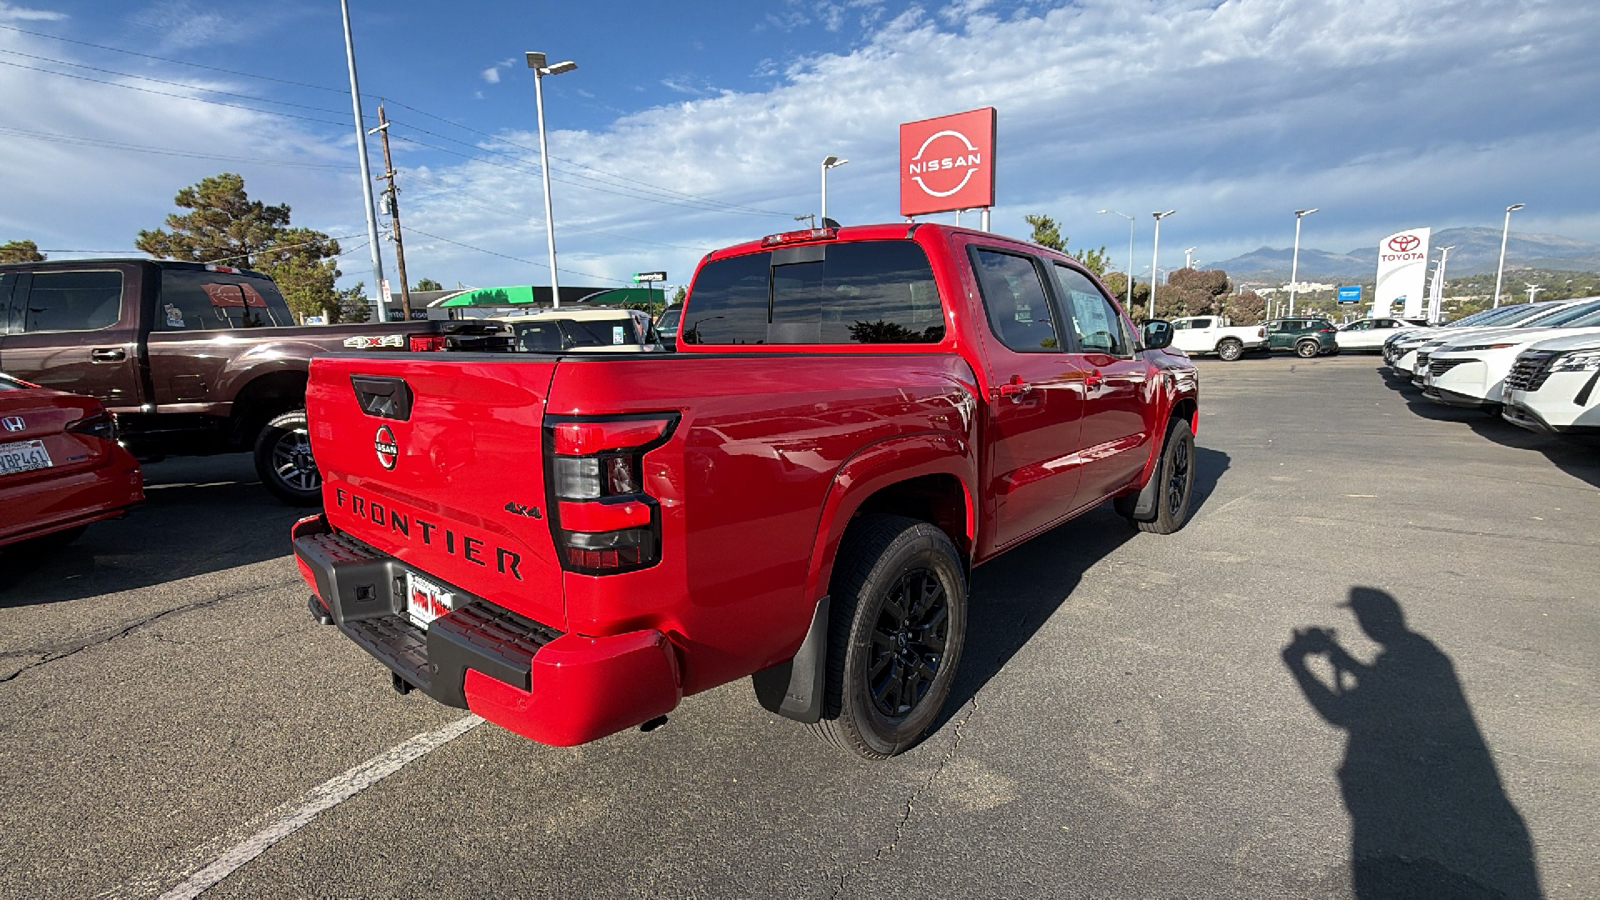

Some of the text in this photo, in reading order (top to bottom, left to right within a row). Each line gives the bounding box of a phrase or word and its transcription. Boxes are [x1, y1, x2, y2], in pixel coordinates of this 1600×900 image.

[909, 152, 981, 175] NISSAN
[1381, 252, 1425, 262] TOYOTA
[336, 487, 523, 581] FRONTIER
